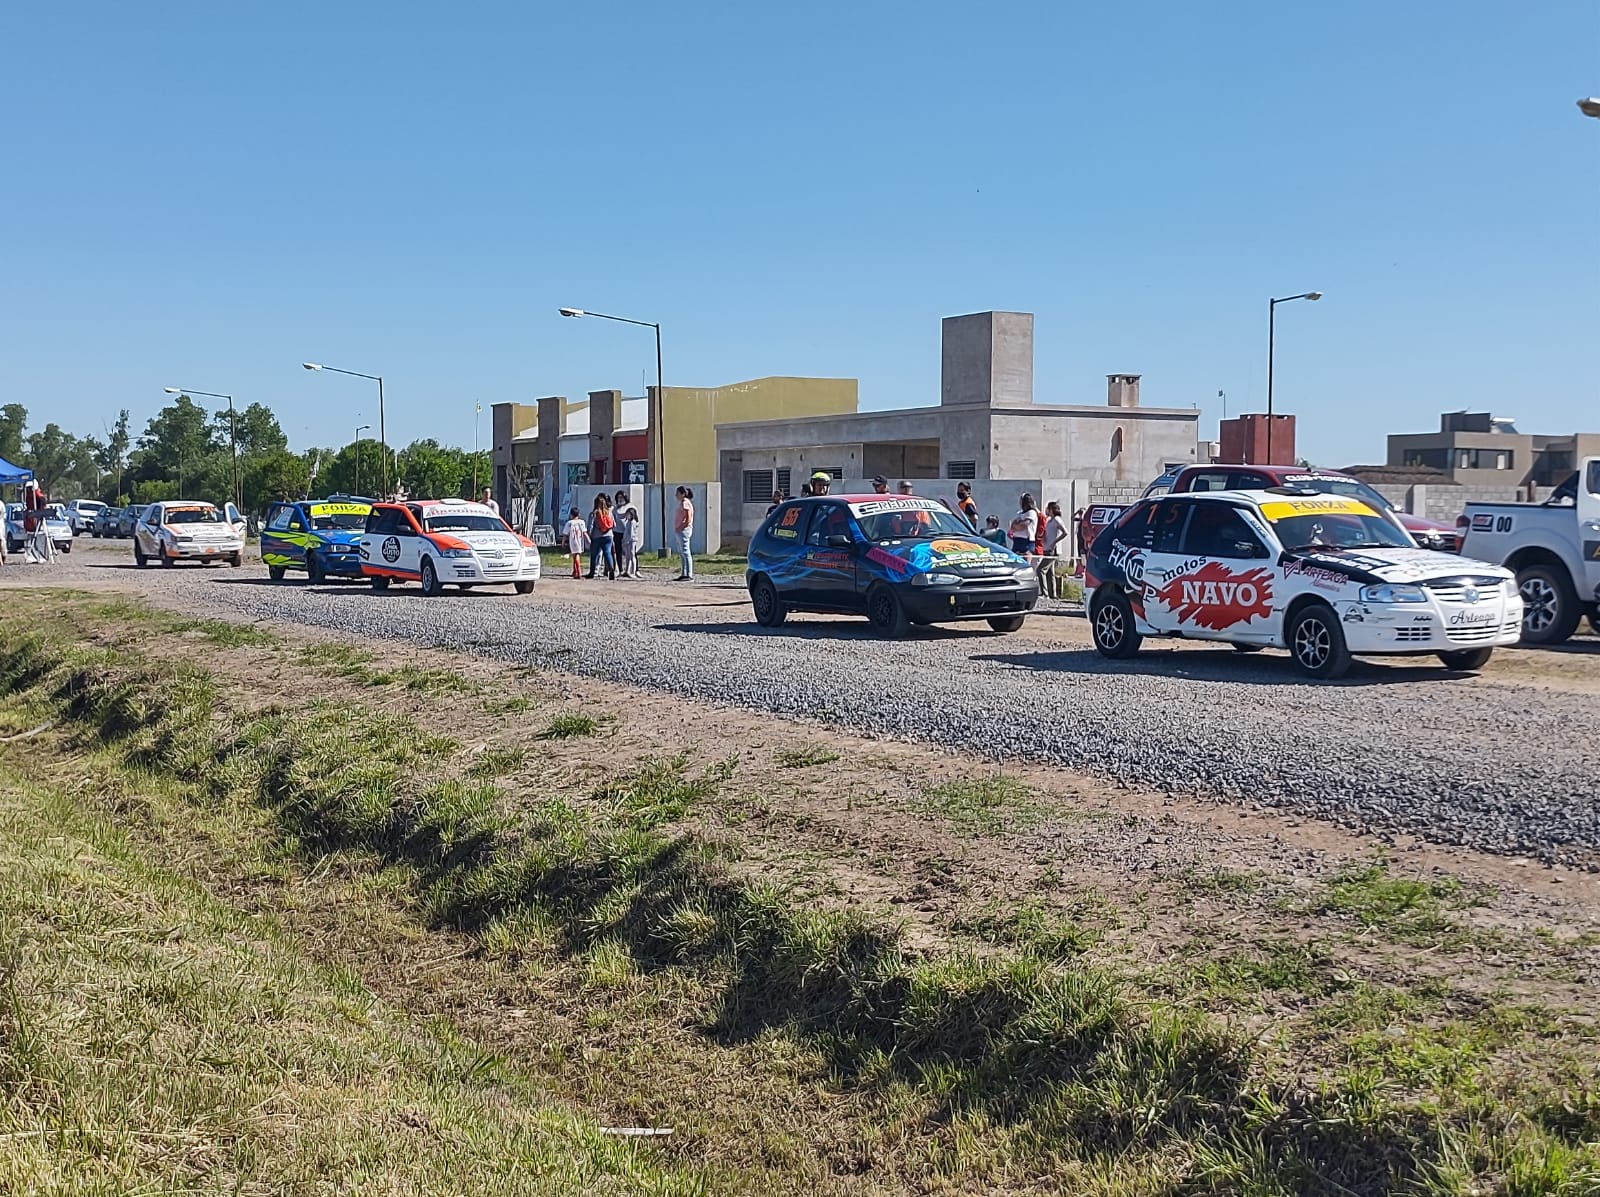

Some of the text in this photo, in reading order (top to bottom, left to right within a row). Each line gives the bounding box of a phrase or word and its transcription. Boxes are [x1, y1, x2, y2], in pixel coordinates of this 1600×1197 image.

[321, 504, 368, 514] FORZA
[1496, 516, 1512, 533] 00
[1161, 556, 1207, 582] motos
[1303, 565, 1349, 585] ARTEAGA
[1182, 580, 1258, 607] NAVO
[1450, 611, 1496, 628] Arteaga
